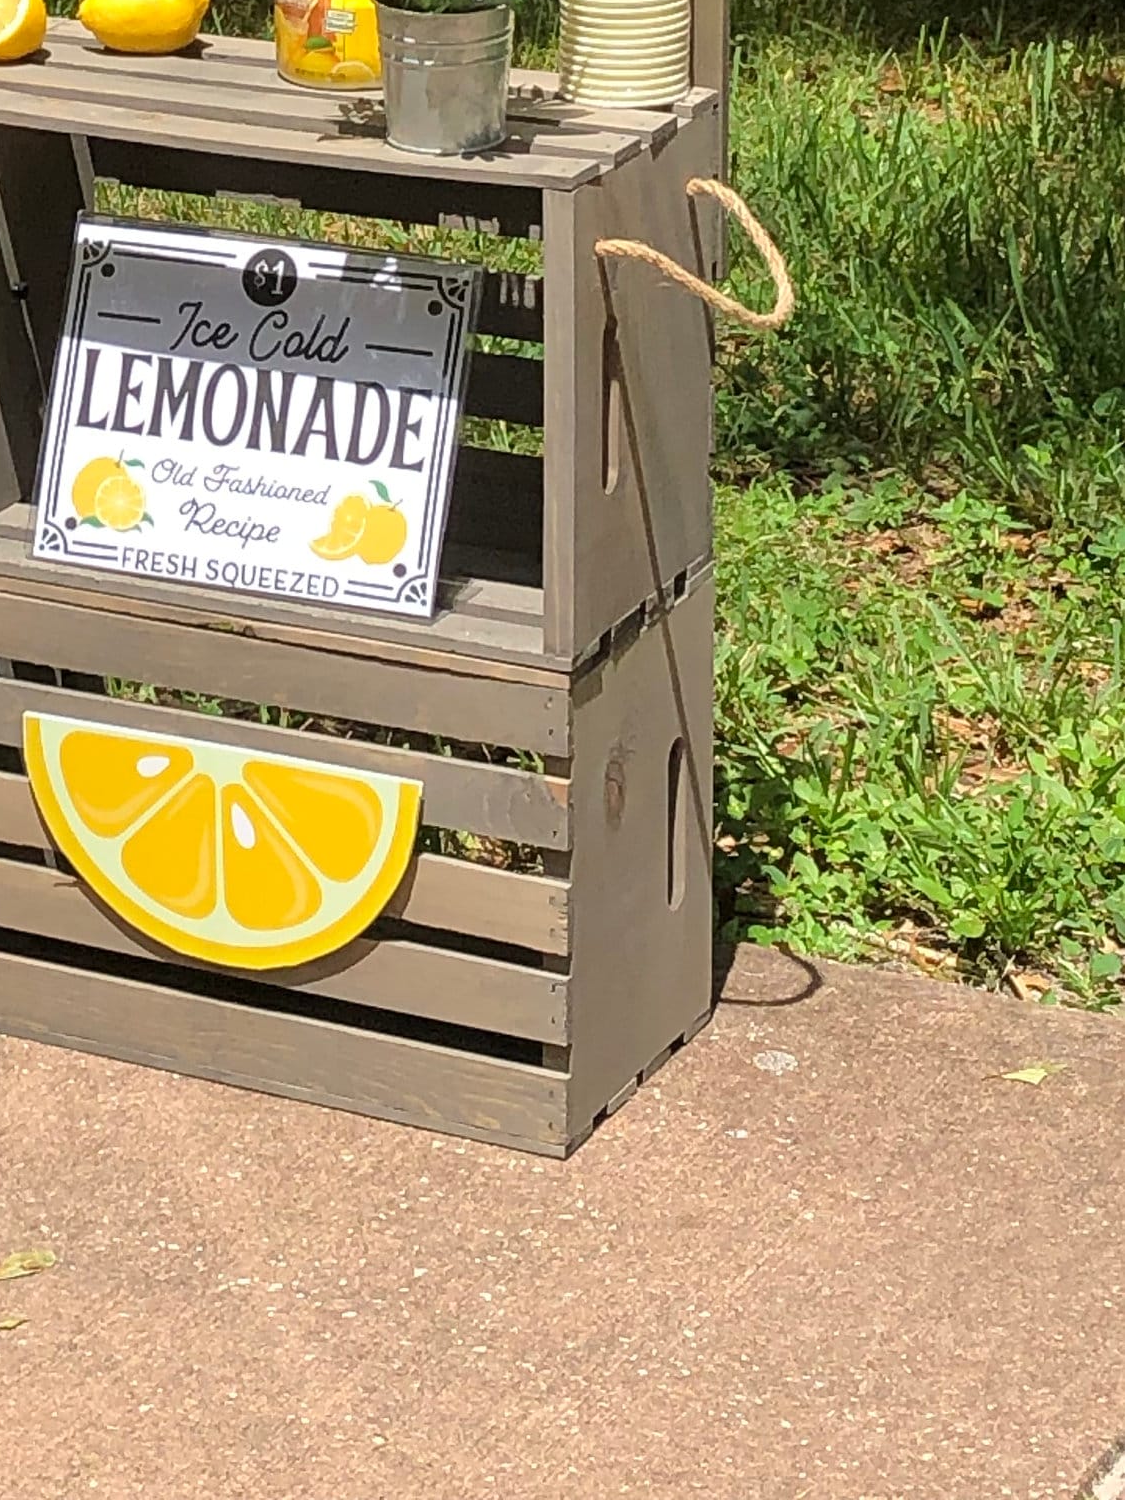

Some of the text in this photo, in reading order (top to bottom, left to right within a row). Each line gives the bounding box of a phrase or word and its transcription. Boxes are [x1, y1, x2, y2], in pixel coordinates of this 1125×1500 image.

[251, 258, 285, 296] $1
[169, 302, 352, 364] Ice Cold
[74, 348, 433, 473] LEMONADE
[151, 457, 331, 506] Old Fashioned
[179, 498, 281, 549] Recipe
[121, 546, 339, 599] FRESH SQUEEZED
